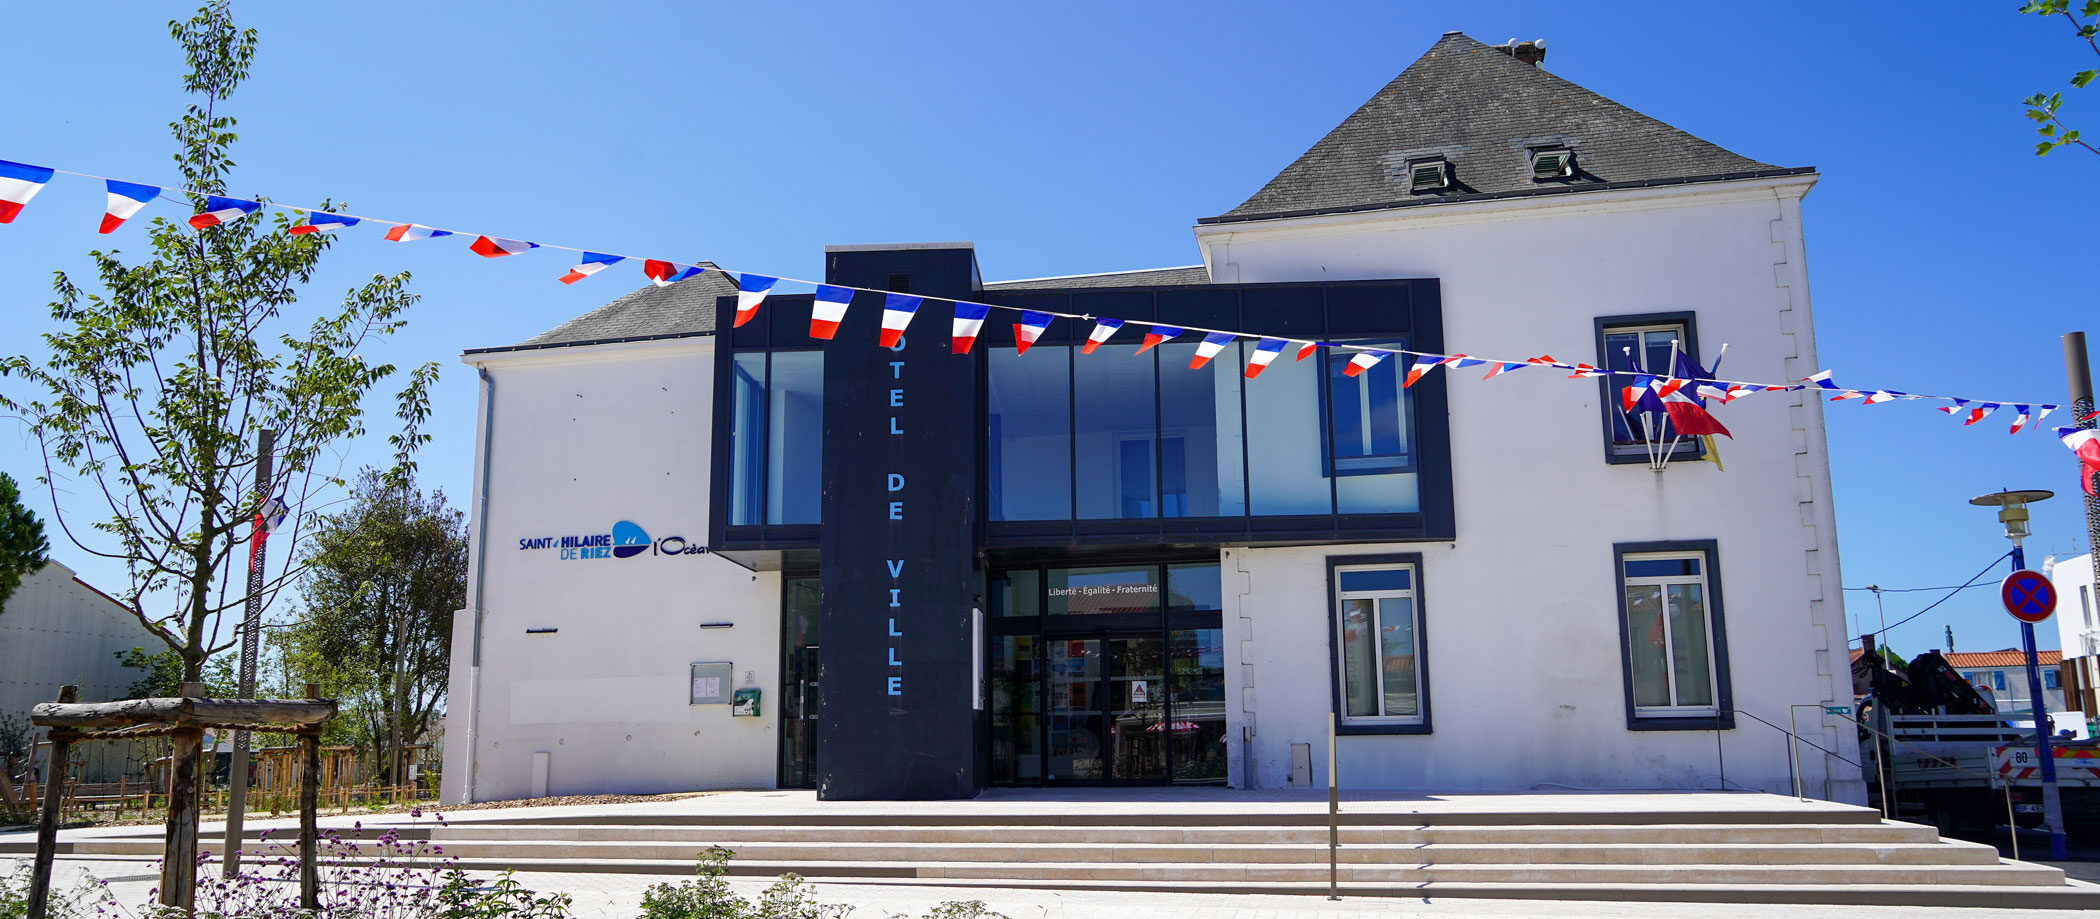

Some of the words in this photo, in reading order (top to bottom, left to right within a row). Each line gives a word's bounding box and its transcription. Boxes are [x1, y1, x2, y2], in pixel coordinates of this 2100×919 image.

[887, 473, 905, 519] DE
[520, 537, 553, 550] SAINT
[561, 534, 611, 548] HILAIRE
[560, 548, 577, 560] DE
[580, 547, 611, 560] RIEZ
[1048, 587, 1077, 596] Liberté
[1083, 585, 1111, 596] Égalité
[1117, 584, 1158, 594] Fraternité
[886, 559, 904, 695] VILLE
[2015, 752, 2028, 763] 80
